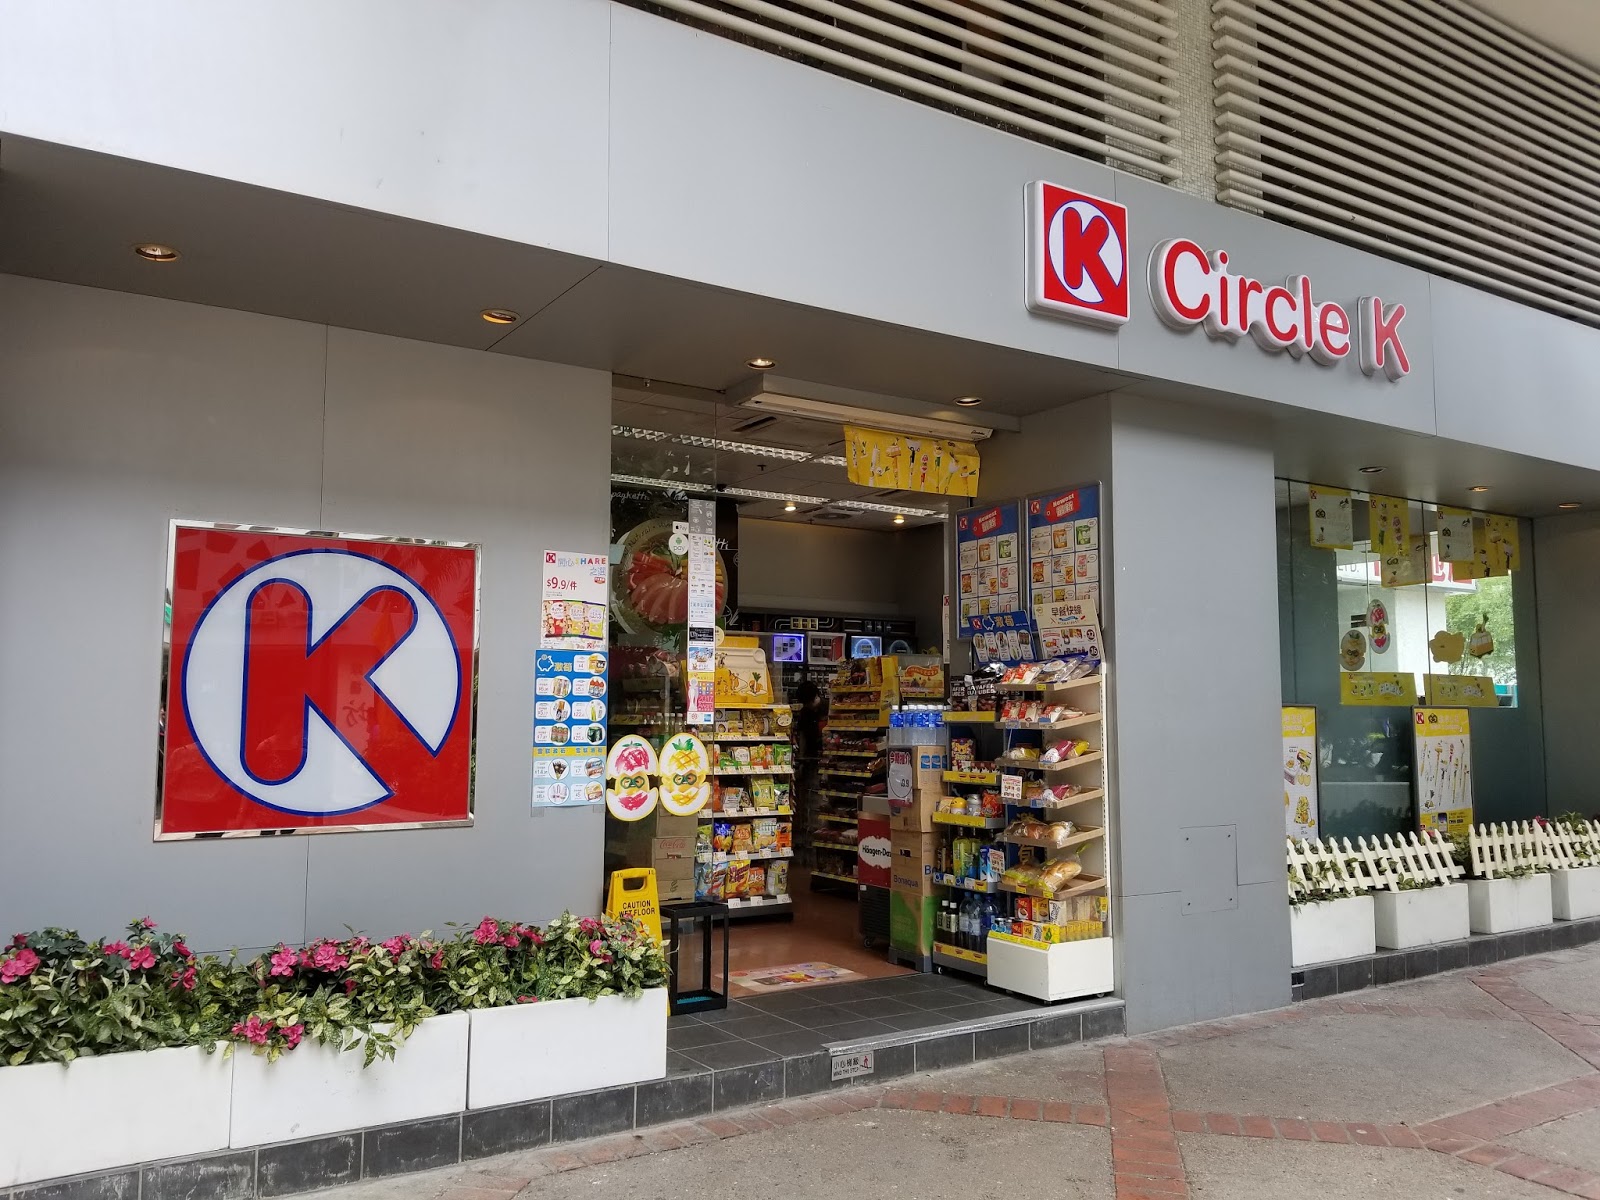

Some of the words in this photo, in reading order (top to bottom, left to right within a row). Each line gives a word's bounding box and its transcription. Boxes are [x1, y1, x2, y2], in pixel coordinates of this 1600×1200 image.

[1063, 207, 1120, 302] K
[1164, 237, 1351, 357] Circle
[1373, 296, 1411, 375] K
[611, 490, 650, 503] paghetti
[575, 557, 606, 565] SHARE
[239, 577, 437, 798] K
[893, 874, 918, 887] Bonaqua
[622, 899, 651, 910] CAUTION
[619, 909, 633, 918] WET
[633, 907, 656, 916] FLOOR
